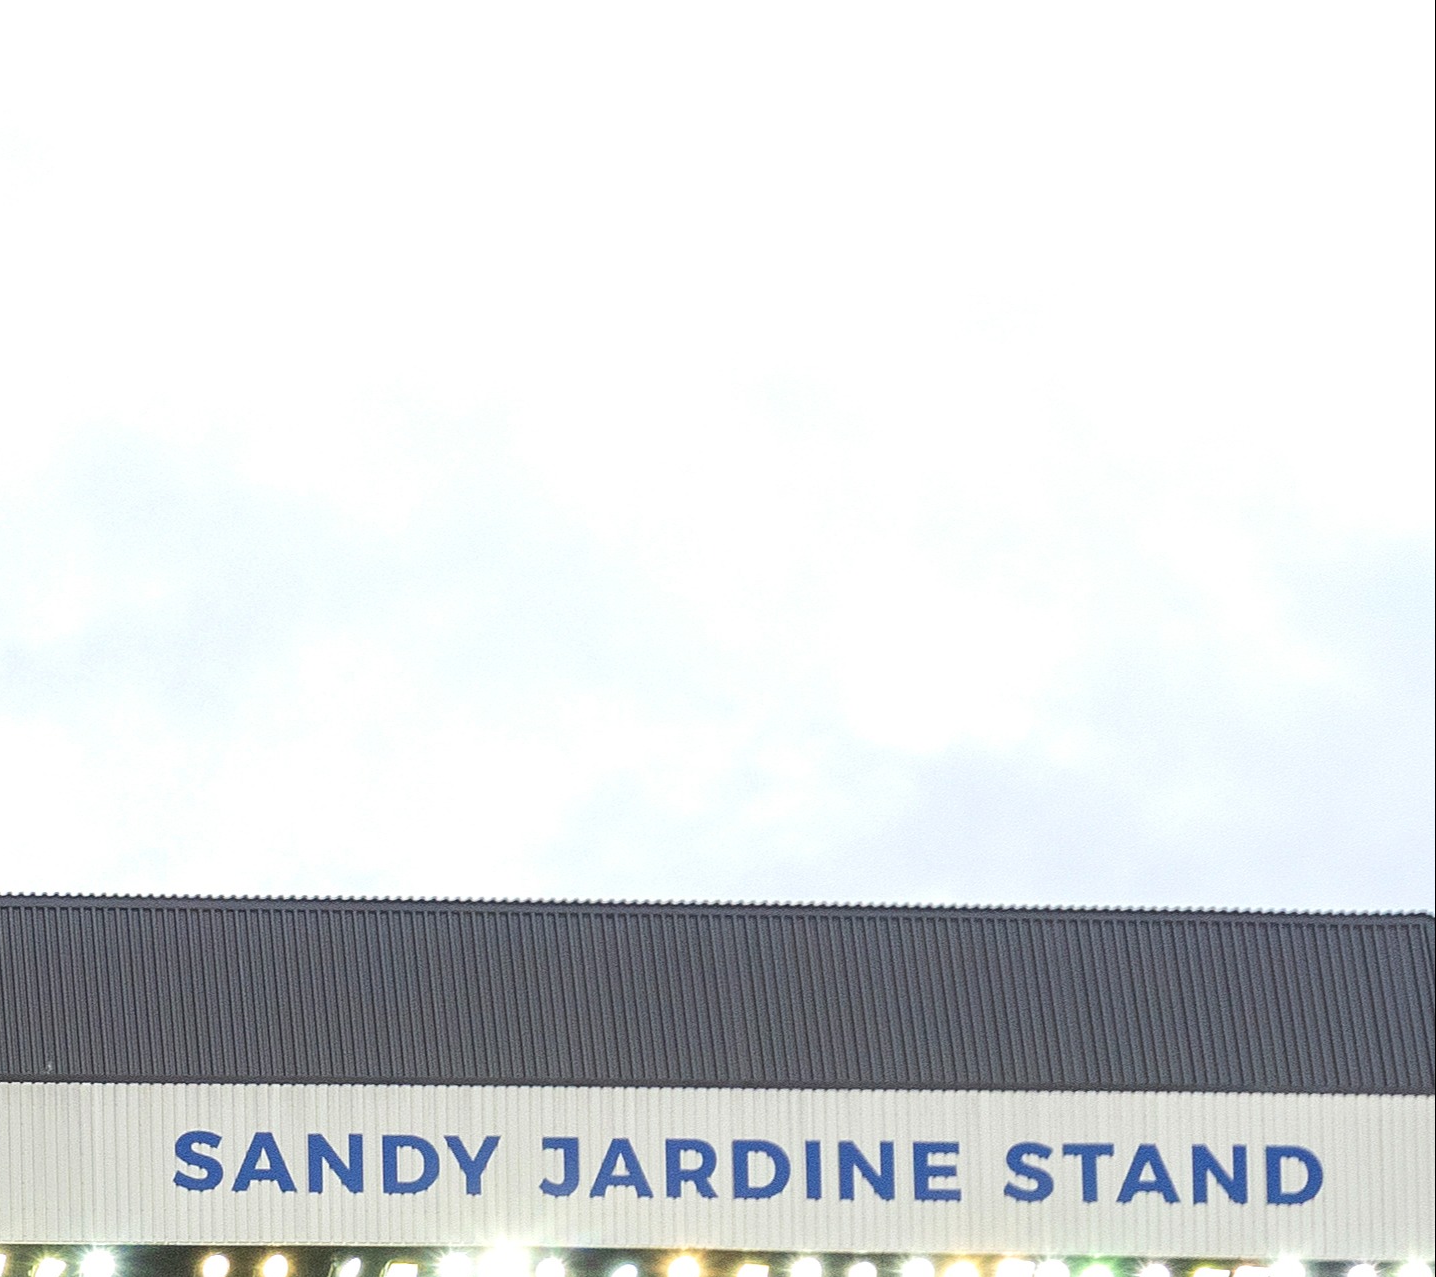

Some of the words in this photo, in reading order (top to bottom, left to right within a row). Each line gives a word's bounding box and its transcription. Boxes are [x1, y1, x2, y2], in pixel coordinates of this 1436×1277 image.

[172, 1130, 501, 1196] SANDY
[540, 1136, 962, 1203] JARDINE
[1003, 1142, 1325, 1206] STAND
